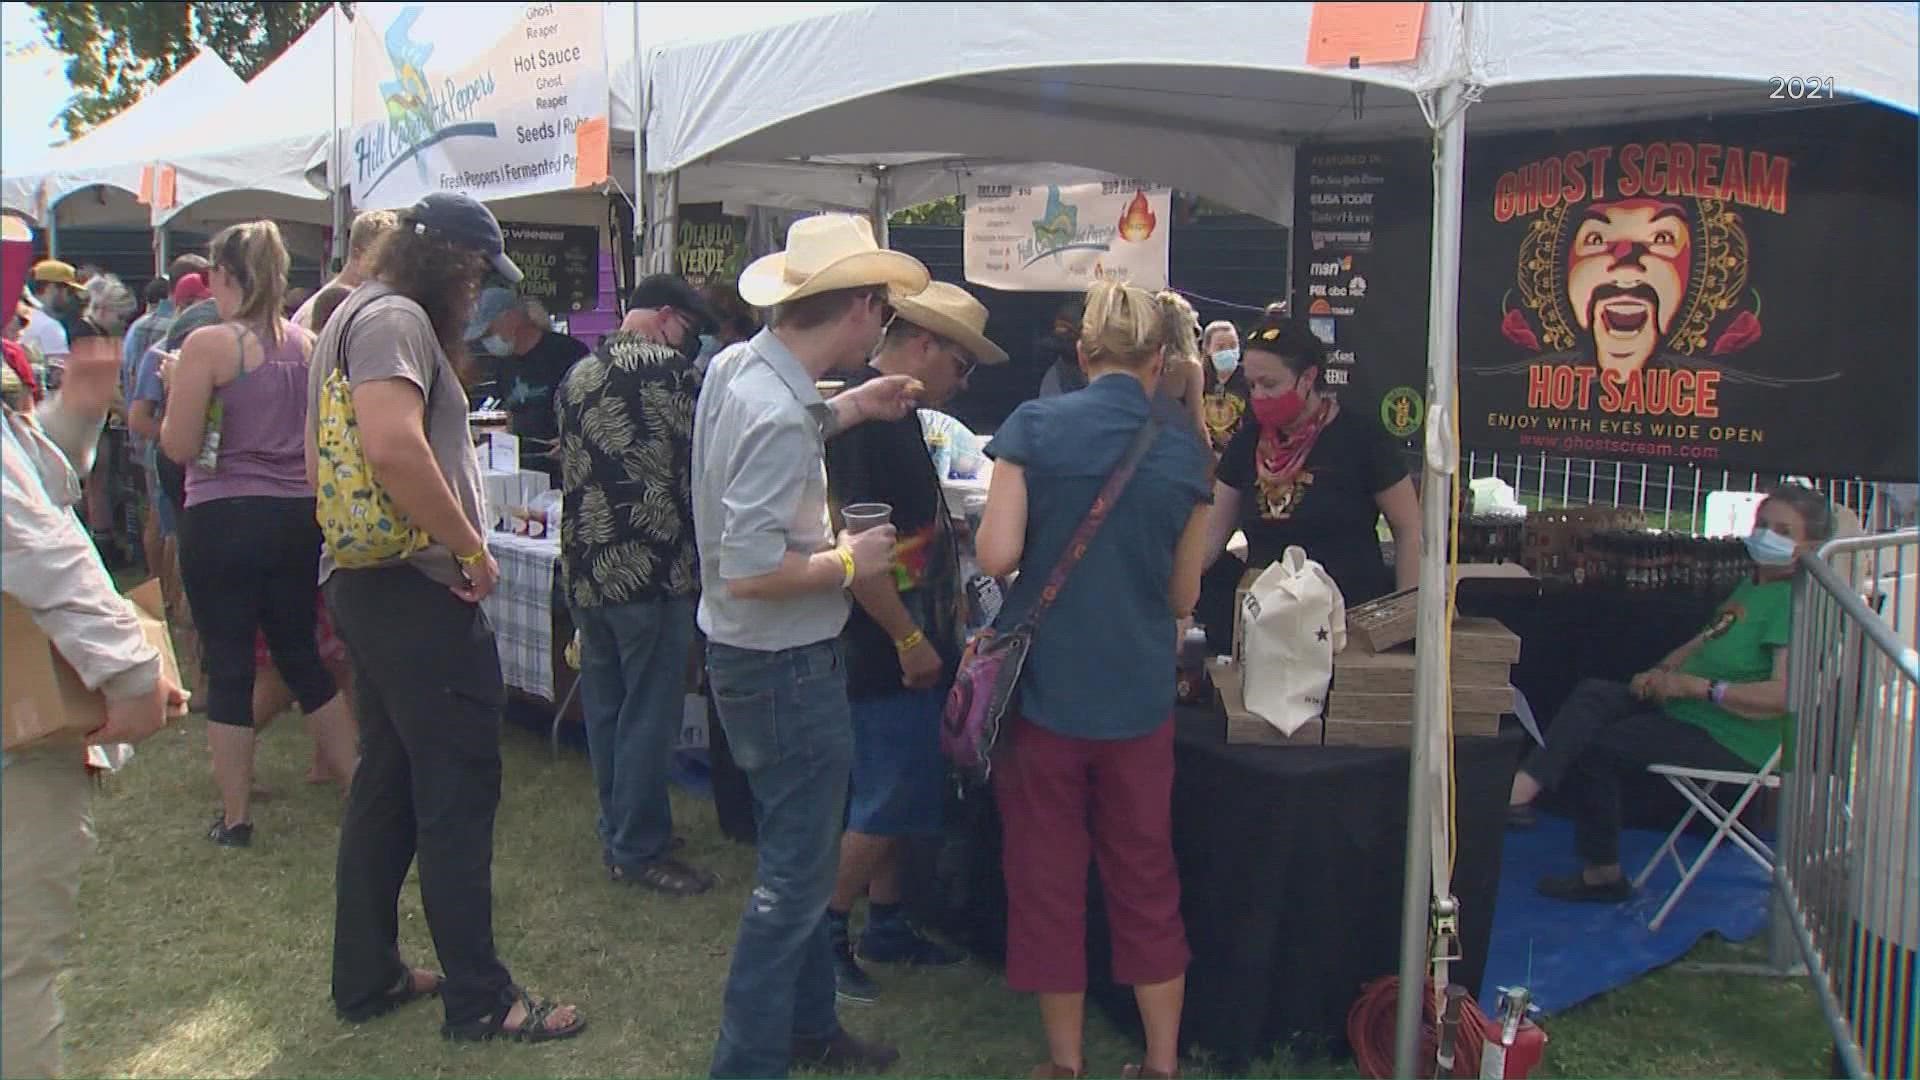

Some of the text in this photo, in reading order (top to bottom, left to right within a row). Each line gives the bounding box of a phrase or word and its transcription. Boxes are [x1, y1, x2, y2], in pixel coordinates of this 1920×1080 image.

[526, 24, 558, 39] Reaper
[514, 46, 581, 73] Hot Sauce
[536, 74, 562, 90] Ghost
[536, 95, 569, 110] Reaper
[354, 122, 385, 185] Hill
[445, 71, 496, 121] Peppers
[516, 122, 555, 144] Seeds
[440, 172, 465, 189] Fresh
[465, 168, 500, 189] Peppers
[506, 157, 562, 182] Fermented
[1494, 141, 1792, 223] GHOST SCREAM
[1320, 193, 1340, 204] USA
[680, 220, 732, 248] DIABLO
[680, 247, 725, 278] VERDE
[1310, 262, 1338, 276] msn
[1527, 365, 1721, 418] HOT SAUCE
[1488, 412, 1764, 443] ENJOY WITH EYES WIDE OPEN
[1519, 433, 1720, 460] www.ghostscream.com
